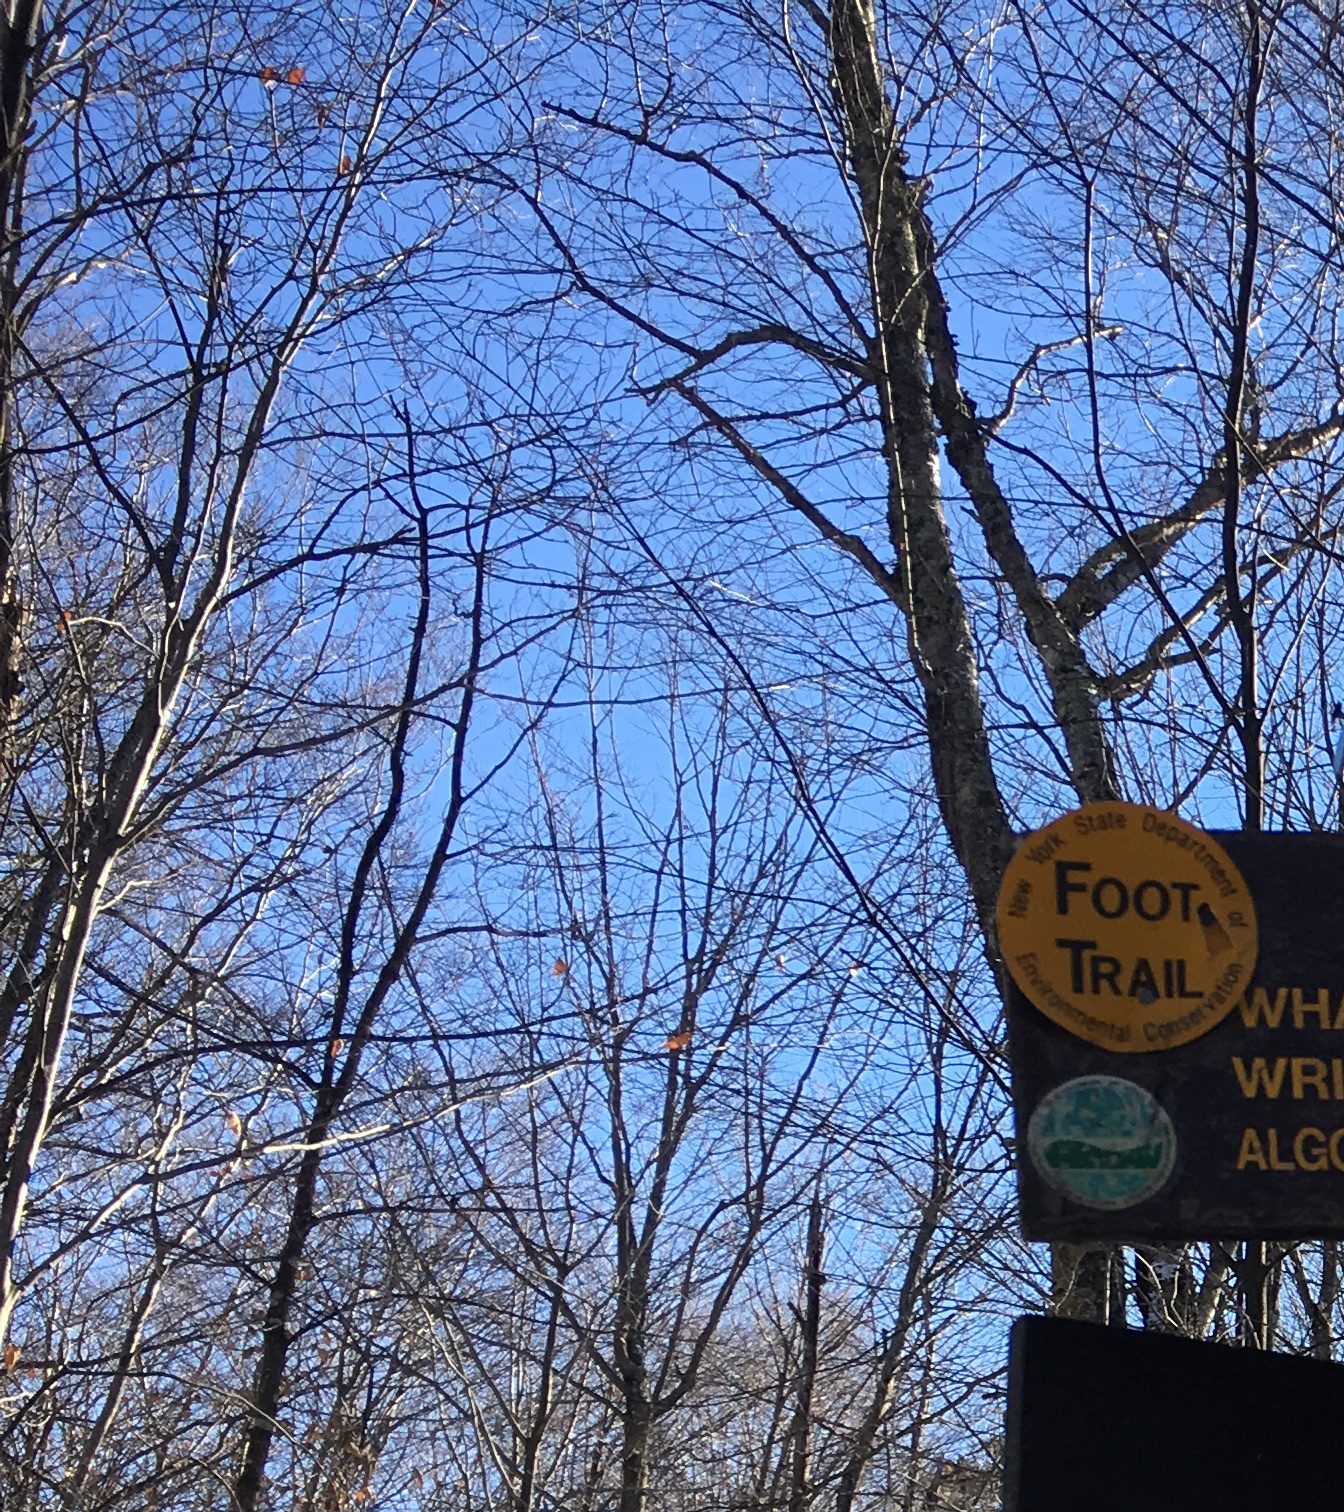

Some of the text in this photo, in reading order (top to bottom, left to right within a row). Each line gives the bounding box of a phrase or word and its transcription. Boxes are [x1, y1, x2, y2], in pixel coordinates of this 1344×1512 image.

[1008, 811, 1248, 928] New York State Department of
[1016, 952, 1243, 1043] Environmental Conservation
